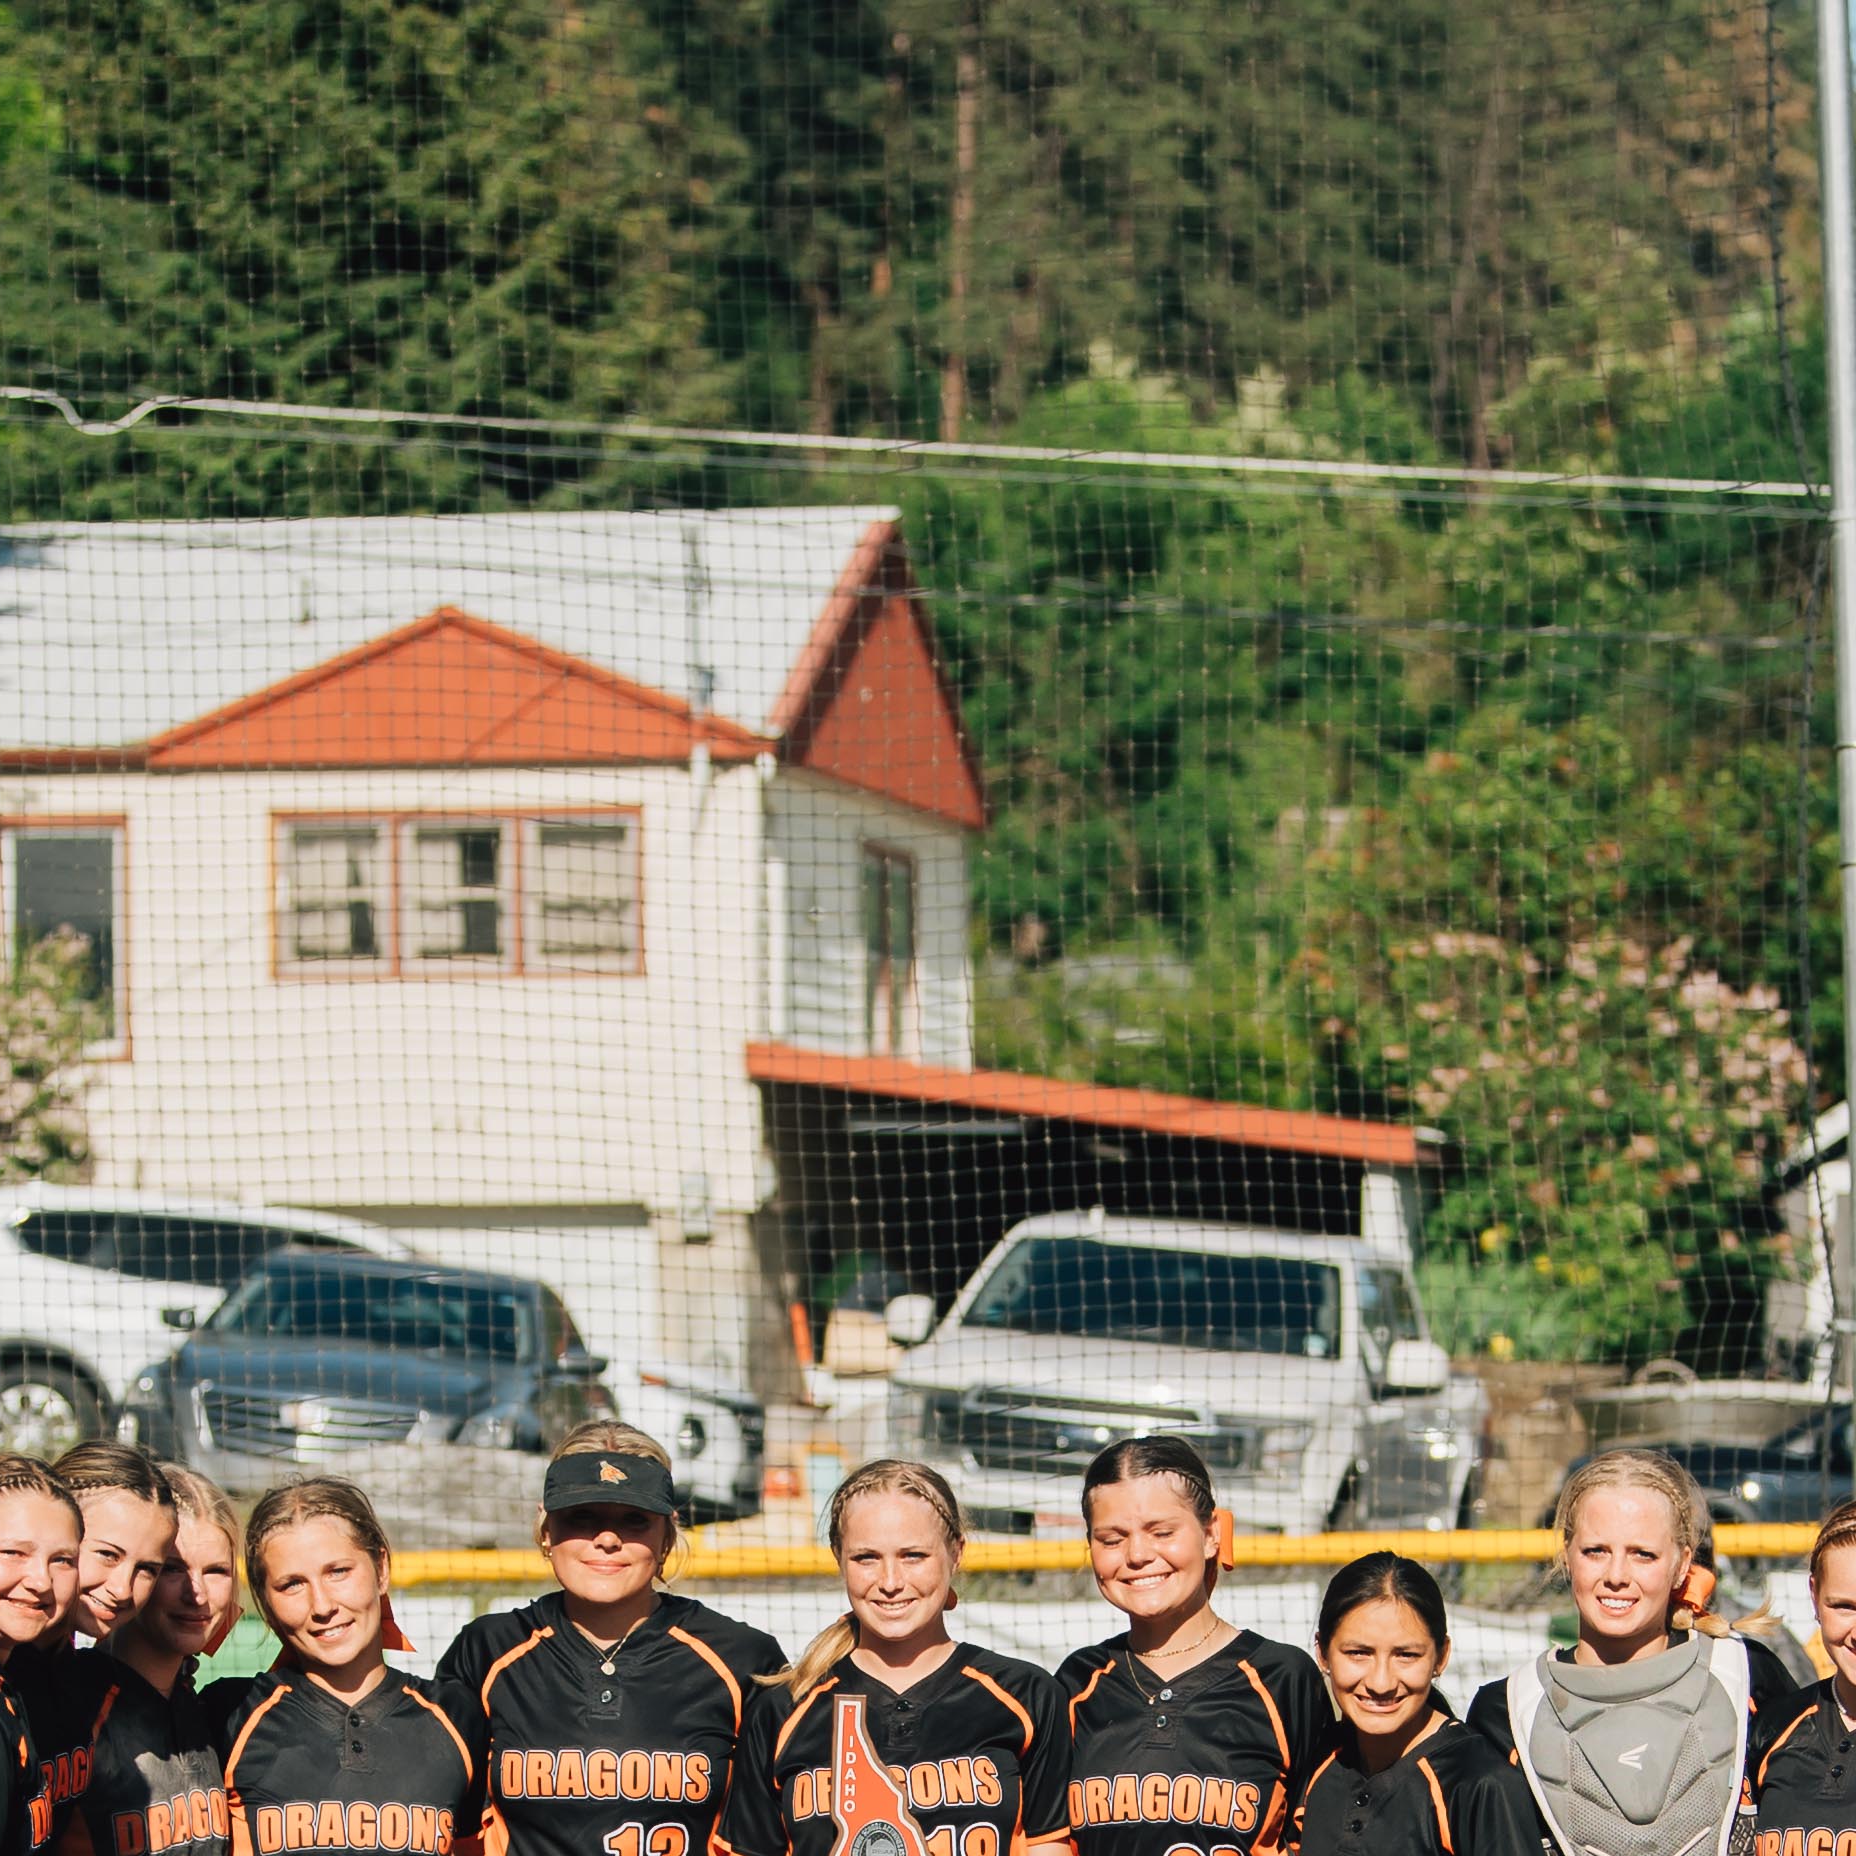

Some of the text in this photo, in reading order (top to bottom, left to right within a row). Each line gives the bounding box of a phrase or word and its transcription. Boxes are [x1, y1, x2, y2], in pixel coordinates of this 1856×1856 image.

[501, 1749, 712, 1804] DRAGONS
[844, 1736, 856, 1813] IDAHO
[1068, 1773, 1260, 1833] DRAGONS
